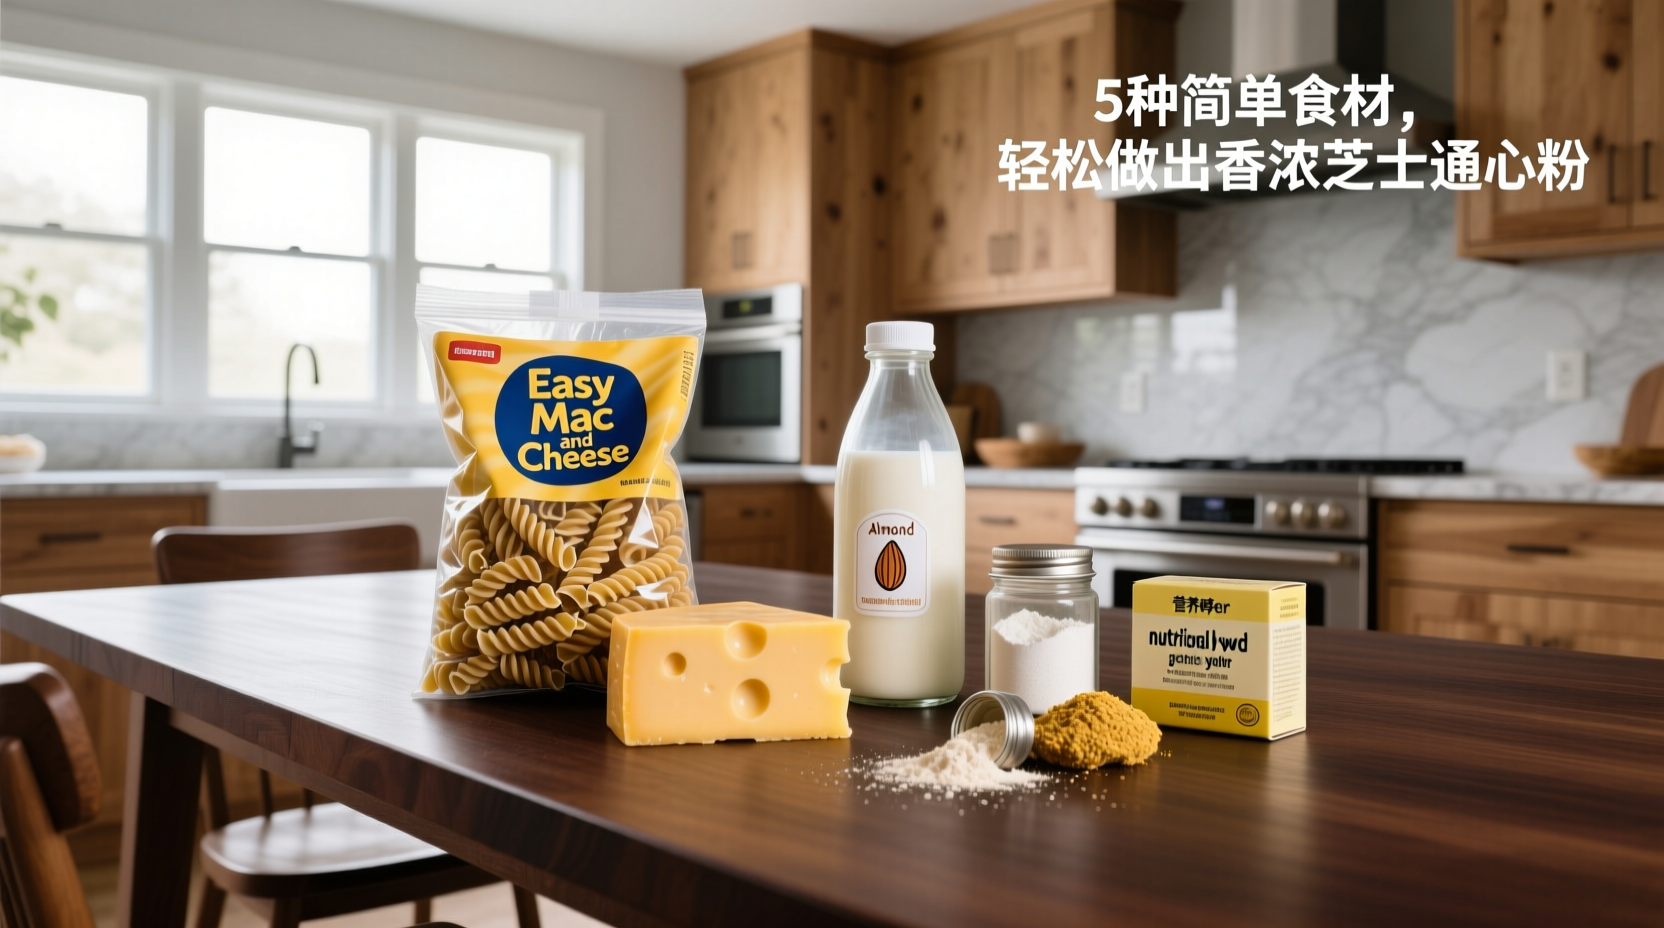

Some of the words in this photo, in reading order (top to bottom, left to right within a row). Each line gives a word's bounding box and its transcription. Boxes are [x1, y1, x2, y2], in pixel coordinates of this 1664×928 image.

[528, 367, 615, 406] Easy
[530, 402, 614, 435] Mac
[560, 432, 593, 449] and
[517, 441, 629, 472] Cheese
[868, 521, 914, 536] Almond
